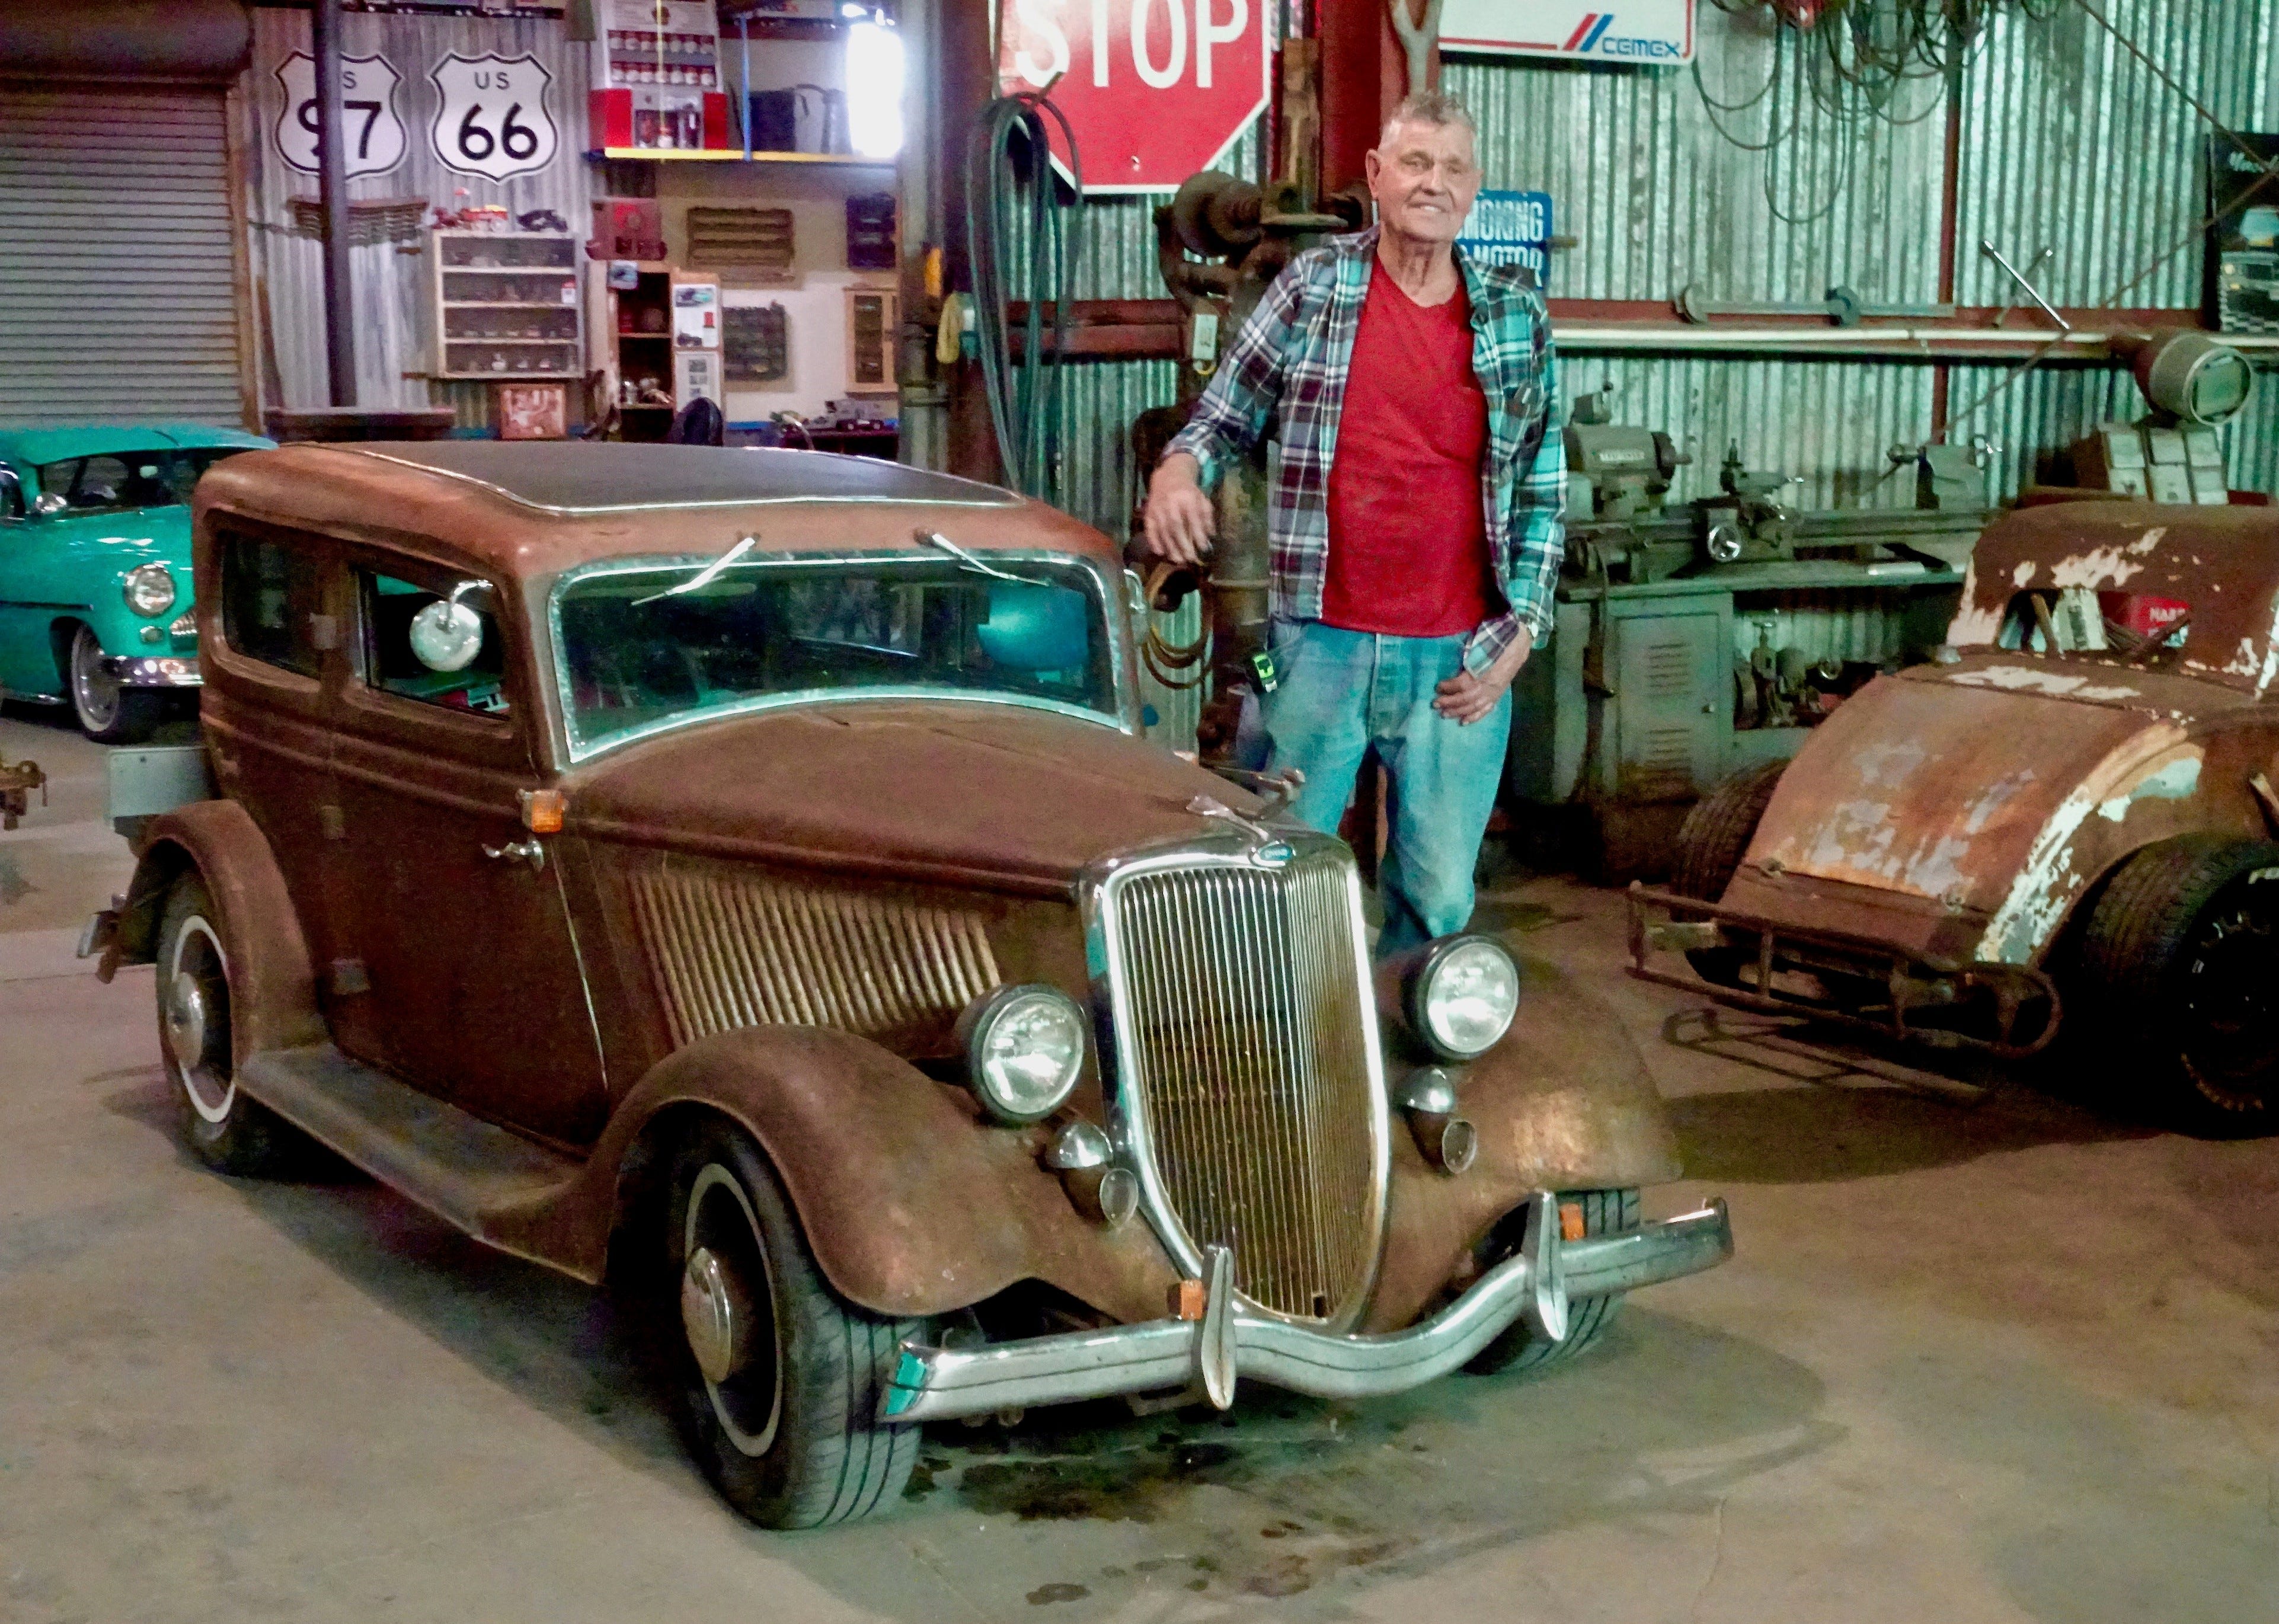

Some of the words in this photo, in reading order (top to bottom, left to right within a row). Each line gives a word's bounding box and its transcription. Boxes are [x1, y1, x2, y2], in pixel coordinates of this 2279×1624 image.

[1015, 0, 1249, 88] STOP
[1602, 37, 1680, 57] CEMEX
[474, 71, 510, 89] US
[459, 102, 538, 161] 66
[1455, 199, 1543, 242] MOKING
